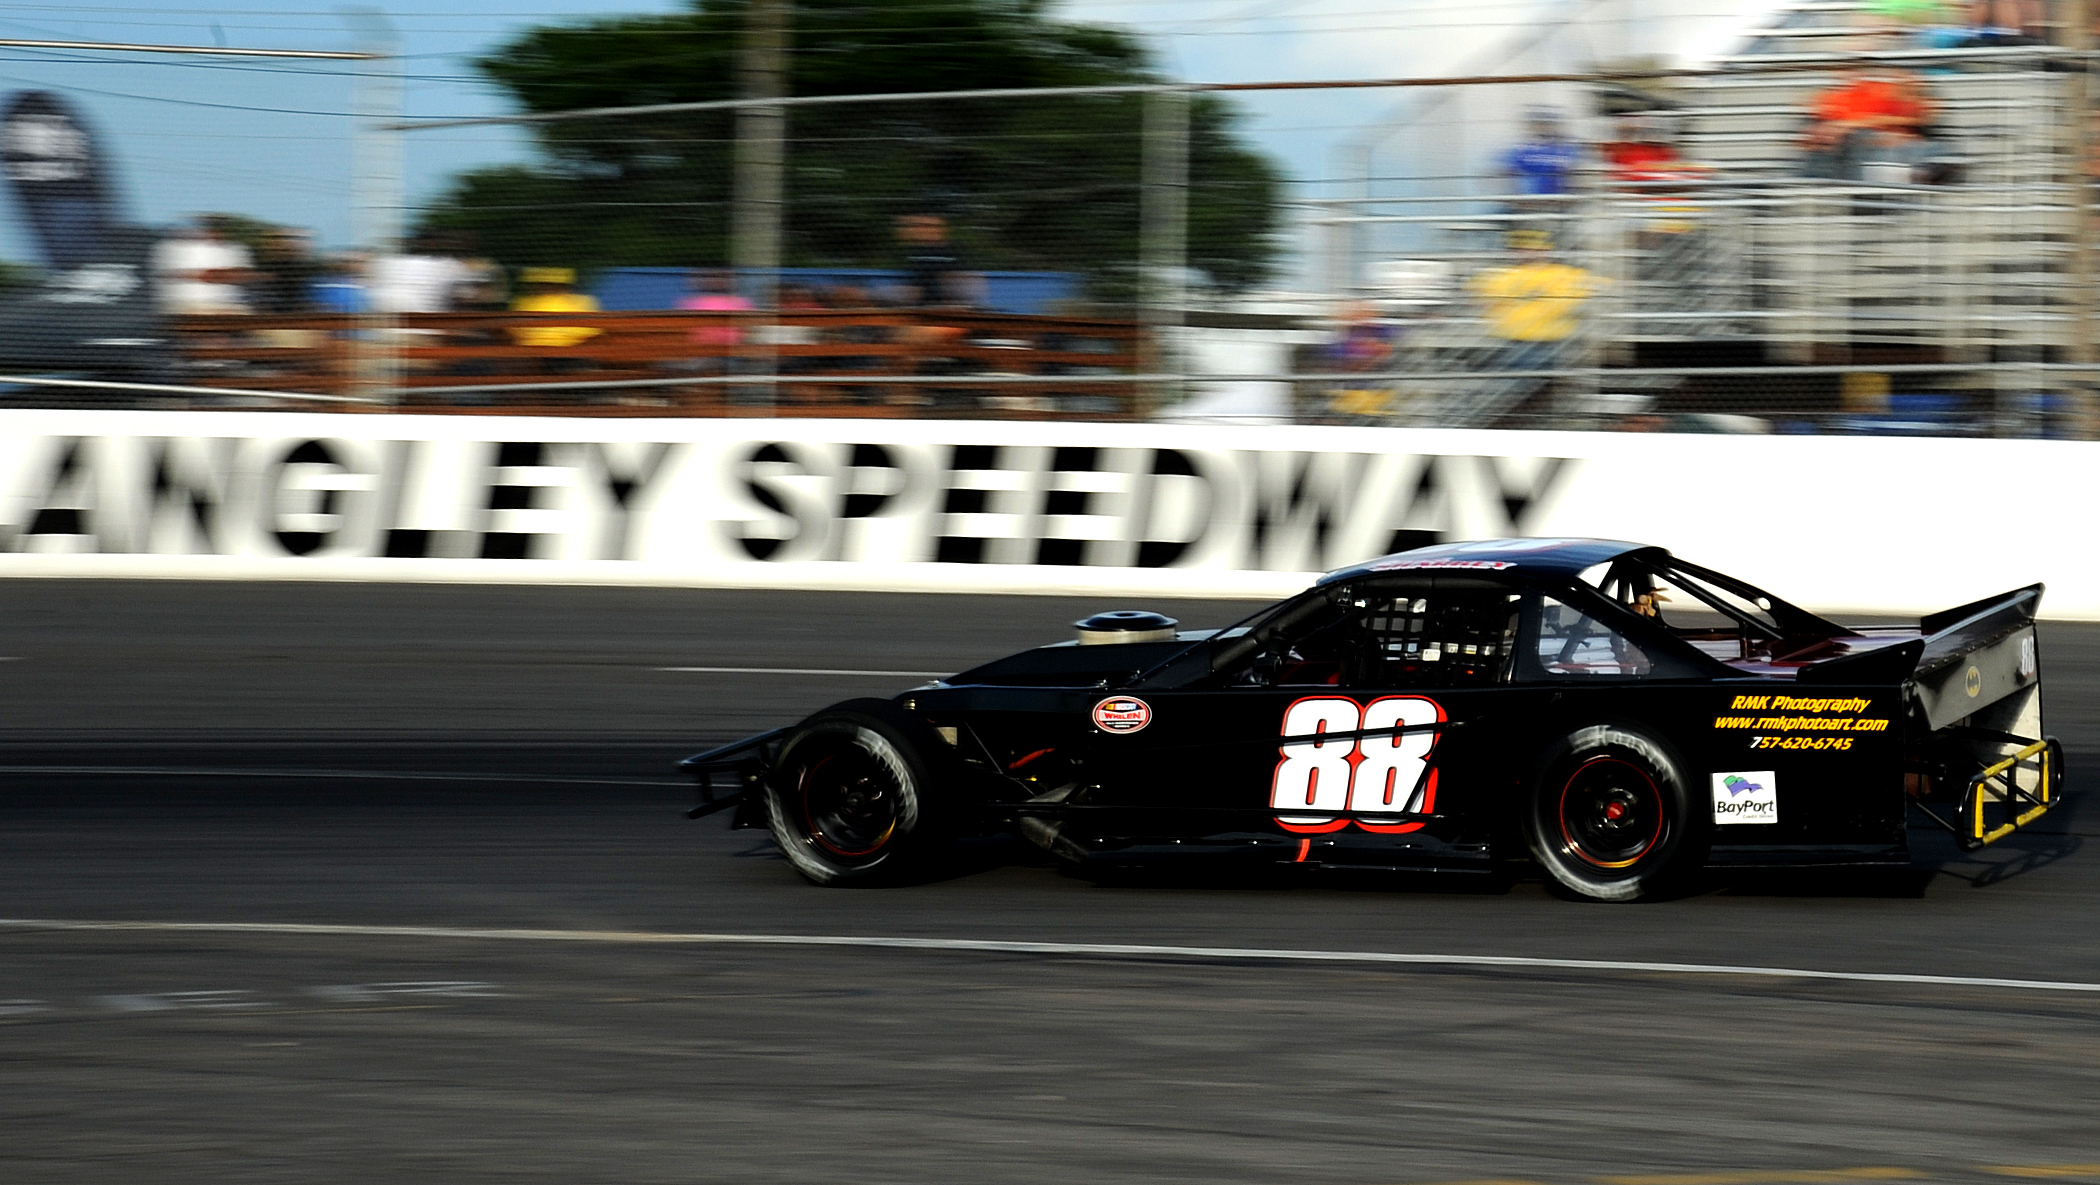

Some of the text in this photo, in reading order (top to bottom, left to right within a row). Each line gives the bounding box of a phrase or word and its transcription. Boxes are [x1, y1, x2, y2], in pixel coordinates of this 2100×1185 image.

[0, 435, 1584, 570] ANGLEY SPEEDWAY
[1731, 696, 1871, 713] RMK Photography
[1714, 716, 1889, 731] www.rmkphotoart.com
[1750, 736, 1854, 750] 757-620-6745
[1269, 695, 1447, 833] 88
[1717, 800, 1774, 816] BayPort
